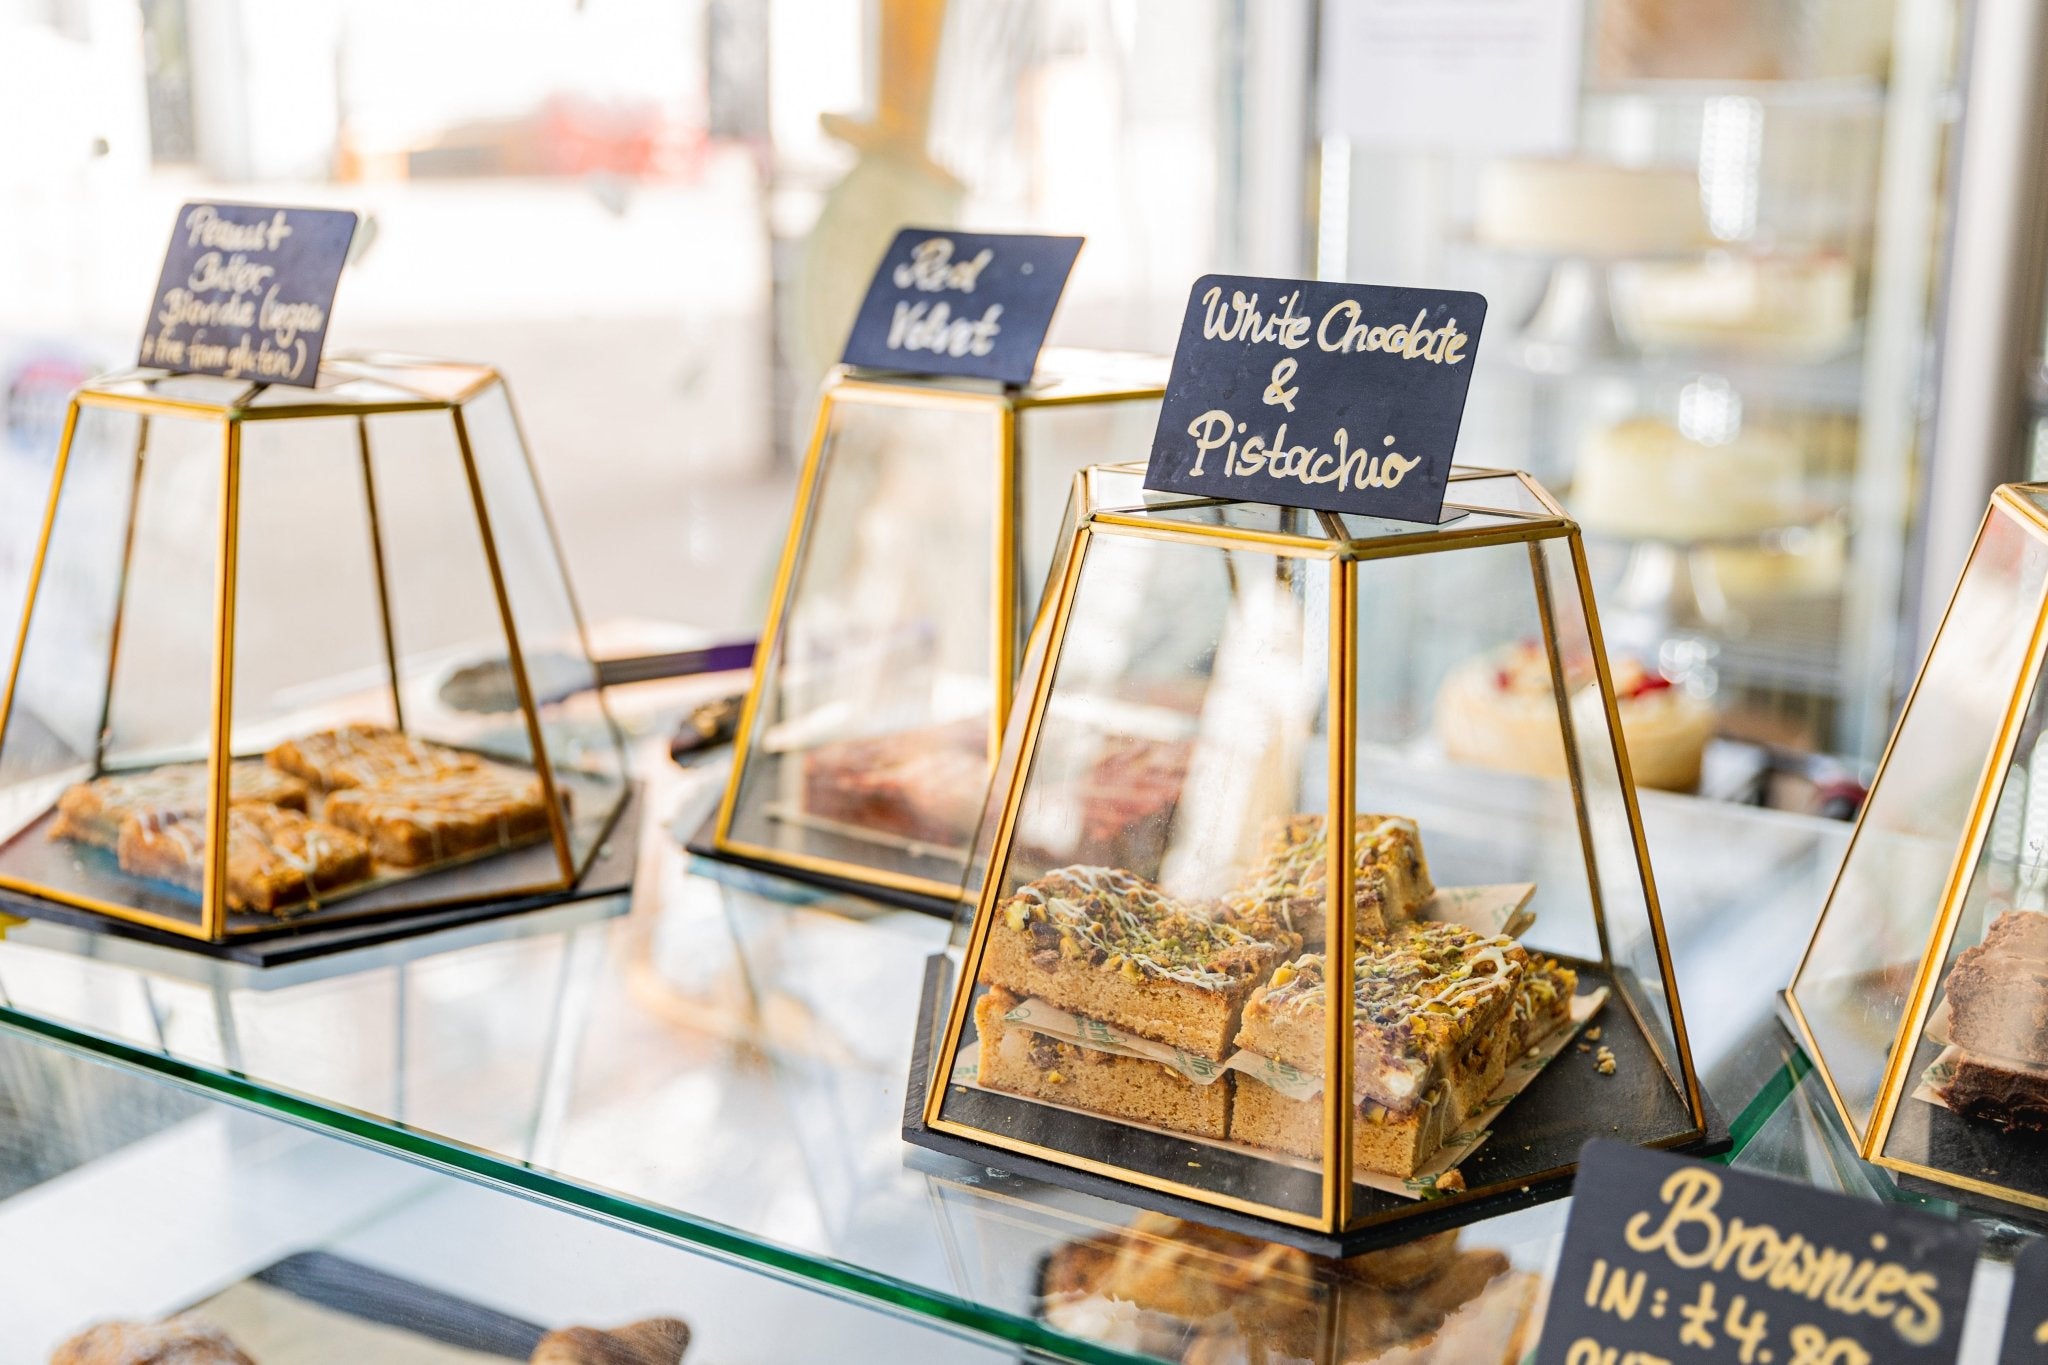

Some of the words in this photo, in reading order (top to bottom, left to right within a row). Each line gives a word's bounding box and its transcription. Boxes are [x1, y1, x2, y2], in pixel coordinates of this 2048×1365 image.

[894, 238, 993, 293] Red
[887, 301, 1004, 357] Velvet
[1203, 287, 1311, 349] White
[1317, 299, 1468, 364] Chocolate
[1262, 357, 1299, 412] &
[1187, 410, 1421, 492] Pistachio
[1625, 1167, 1943, 1346] Brownies
